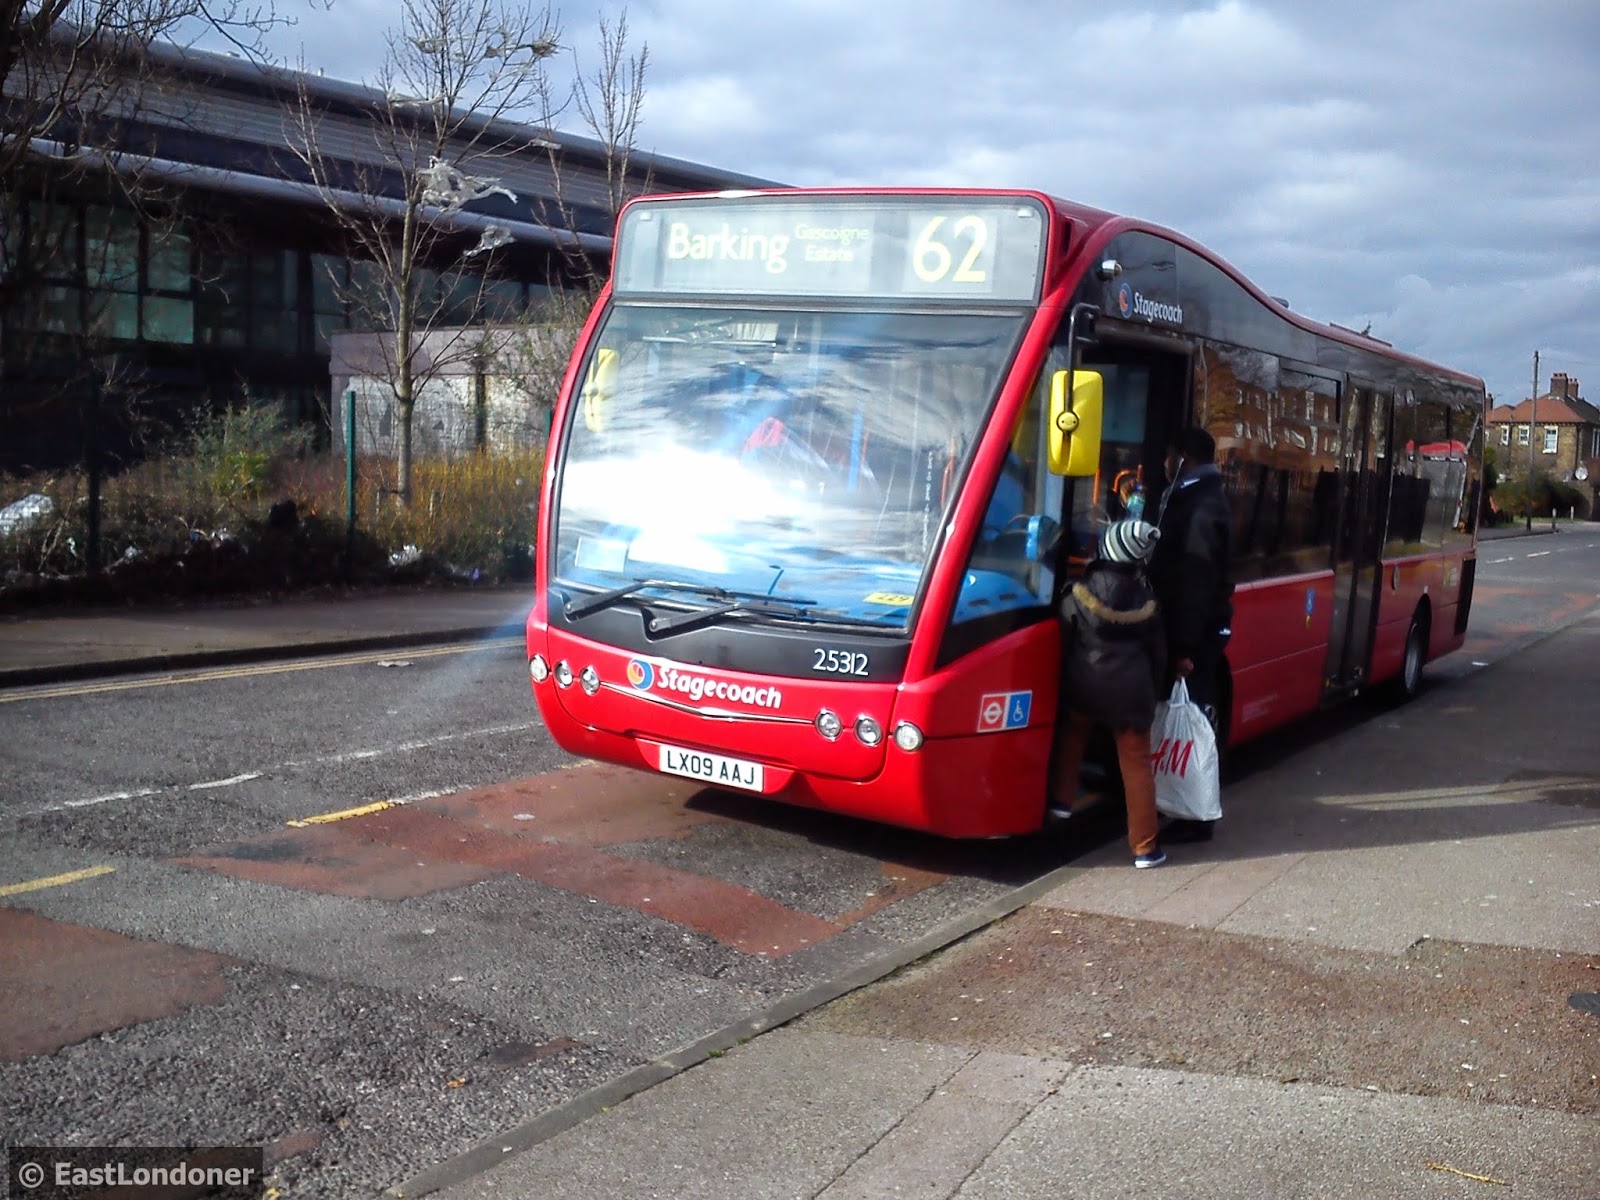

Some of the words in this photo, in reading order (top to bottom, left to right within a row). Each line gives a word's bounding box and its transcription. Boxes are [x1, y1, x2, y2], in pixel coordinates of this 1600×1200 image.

[667, 223, 790, 274] Barking
[794, 223, 870, 246] Gascoigne
[912, 214, 988, 284] 62
[1133, 291, 1184, 324] Stagecoach
[813, 648, 869, 677] 25312
[657, 664, 782, 709] Stagecoach
[667, 750, 713, 777] LX09
[719, 762, 755, 786] AAJ
